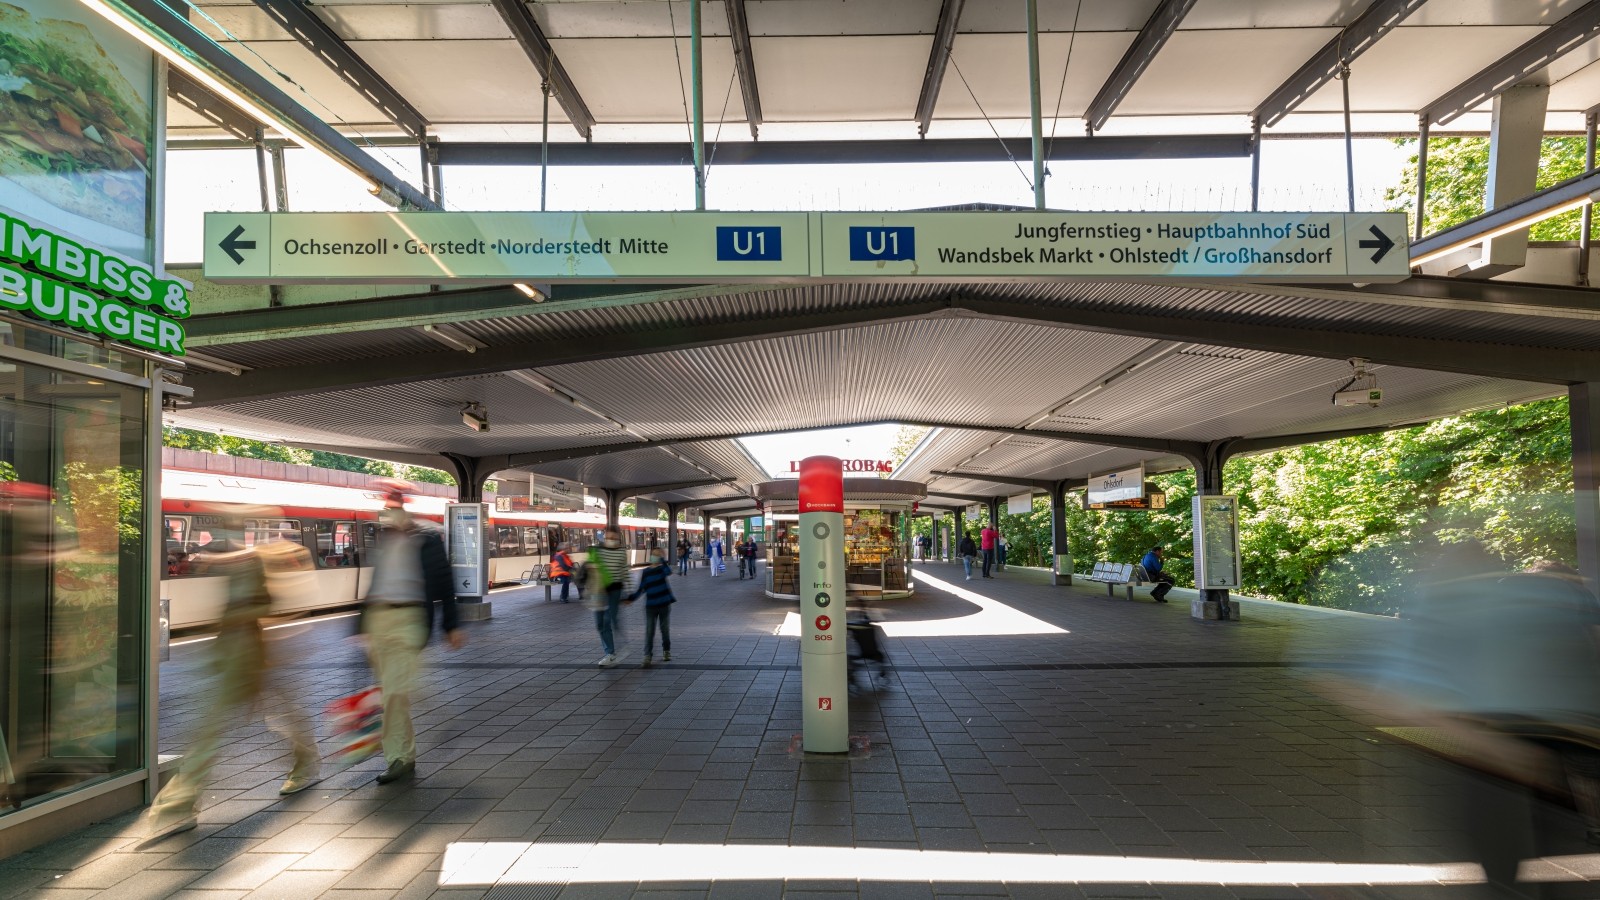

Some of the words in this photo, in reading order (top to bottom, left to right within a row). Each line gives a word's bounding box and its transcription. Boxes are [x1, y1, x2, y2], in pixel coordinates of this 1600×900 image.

[733, 231, 765, 255] U1
[866, 231, 898, 255] U1
[1014, 222, 1141, 243] Jungfernstieg
[1157, 221, 1292, 243] Hauptbahnhof
[1296, 222, 1331, 240] Süd
[284, 238, 388, 255] Ochsenzoll
[404, 238, 486, 255] Garstedt
[498, 237, 612, 255] Norderstedt
[620, 237, 669, 254] Mitte
[937, 246, 1035, 264] Wandsbek
[1039, 247, 1094, 264] Markt
[1110, 246, 1189, 264] Ohlstedt
[1204, 246, 1333, 264] Großhansdorf
[0, 266, 183, 352] BURGER
[163, 283, 188, 314] &
[842, 459, 893, 472] ROBAG
[1104, 477, 1123, 489] Ohlsdorf
